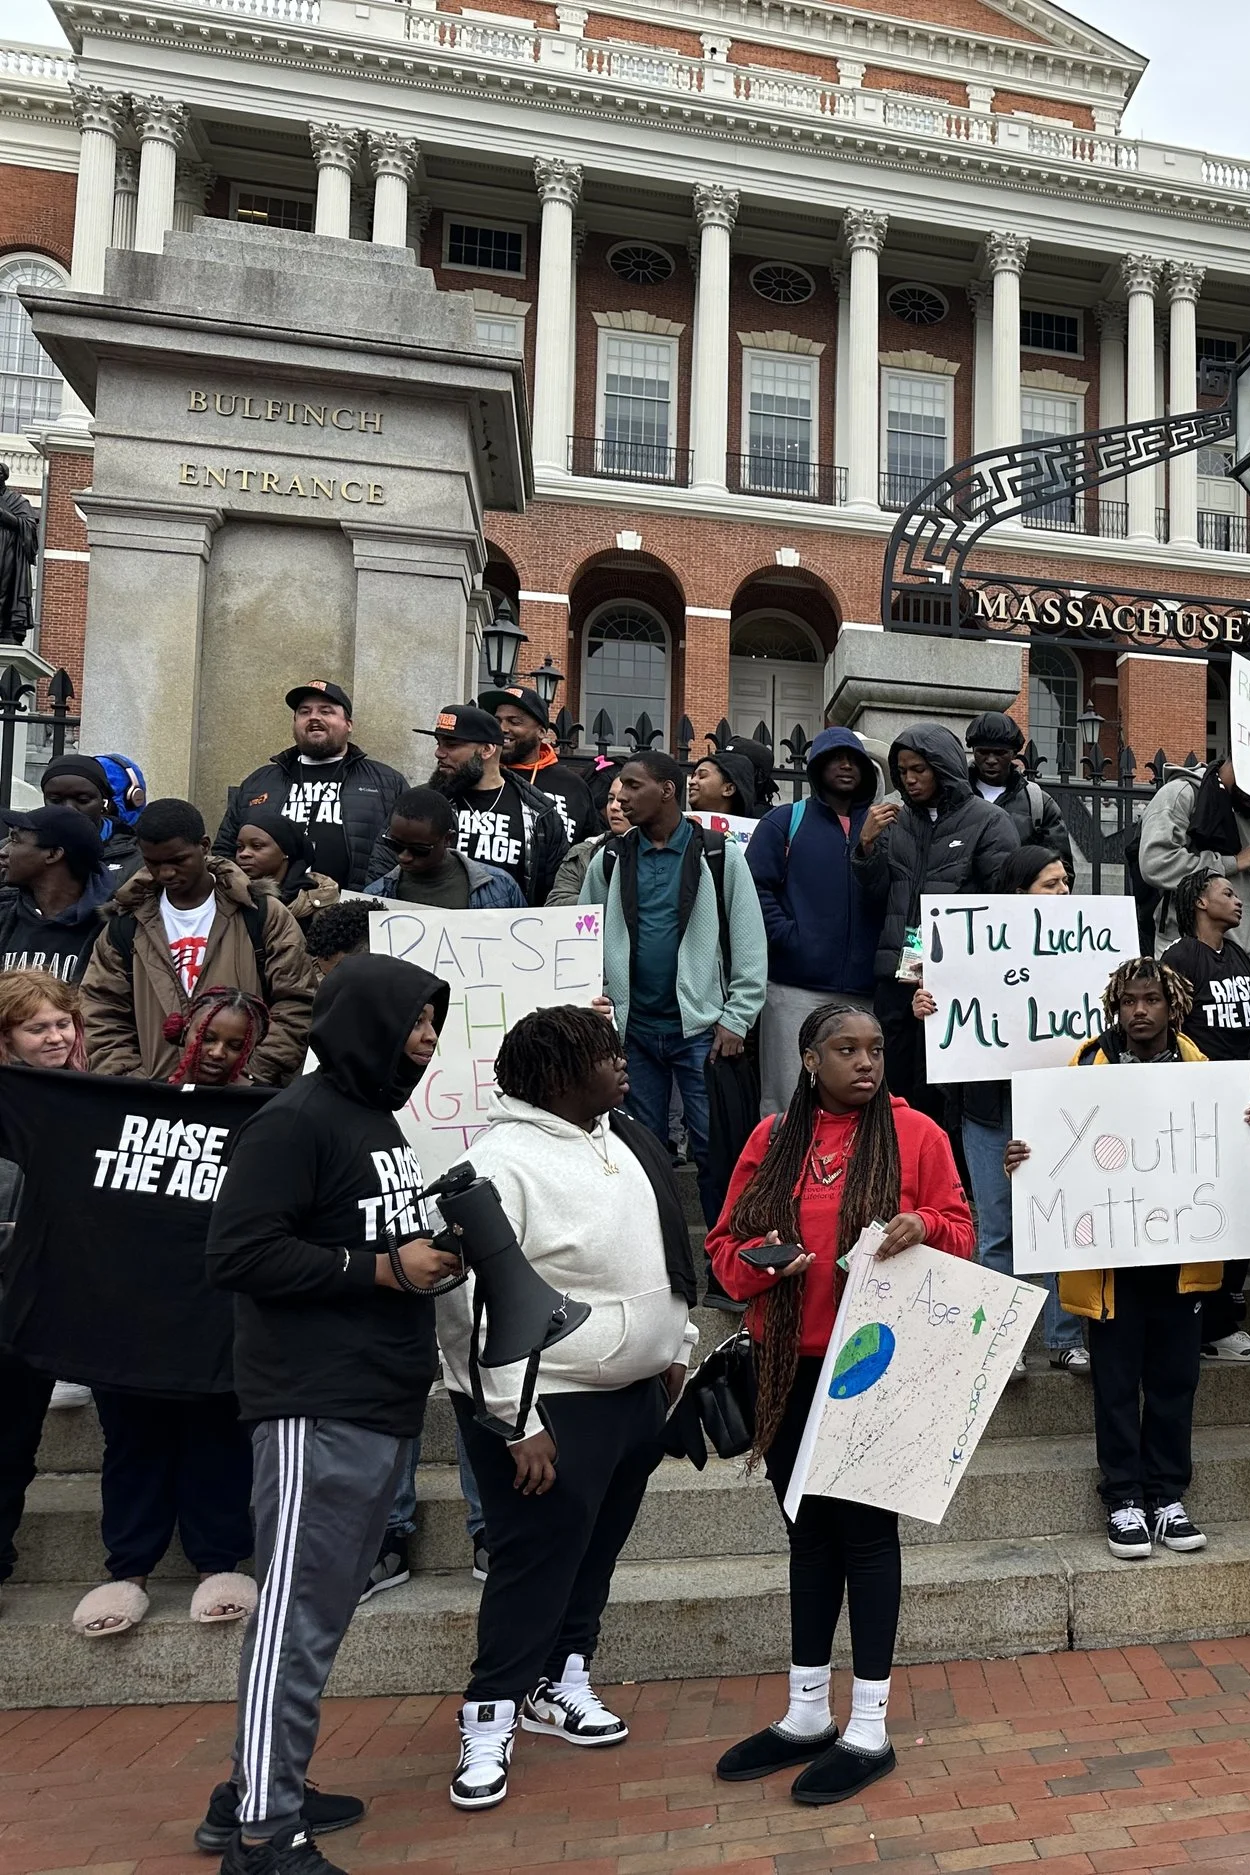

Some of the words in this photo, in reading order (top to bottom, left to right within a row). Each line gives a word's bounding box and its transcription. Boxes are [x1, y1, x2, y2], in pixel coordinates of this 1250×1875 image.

[187, 389, 384, 434] BULFINCH
[178, 462, 386, 505] ENTRANCE
[457, 809, 511, 836] AISE
[474, 835, 522, 866] AGE
[1033, 907, 1120, 956] Lucha
[1003, 967, 1030, 986] es
[939, 997, 1010, 1050] Mi
[1028, 992, 1106, 1043] Luch
[1202, 1003, 1242, 1029] THE
[118, 1114, 229, 1164] RAISE
[93, 1149, 165, 1193] THE
[165, 1158, 228, 1202] AG
[371, 1145, 425, 1194] RAIS
[911, 1268, 961, 1327] Age
